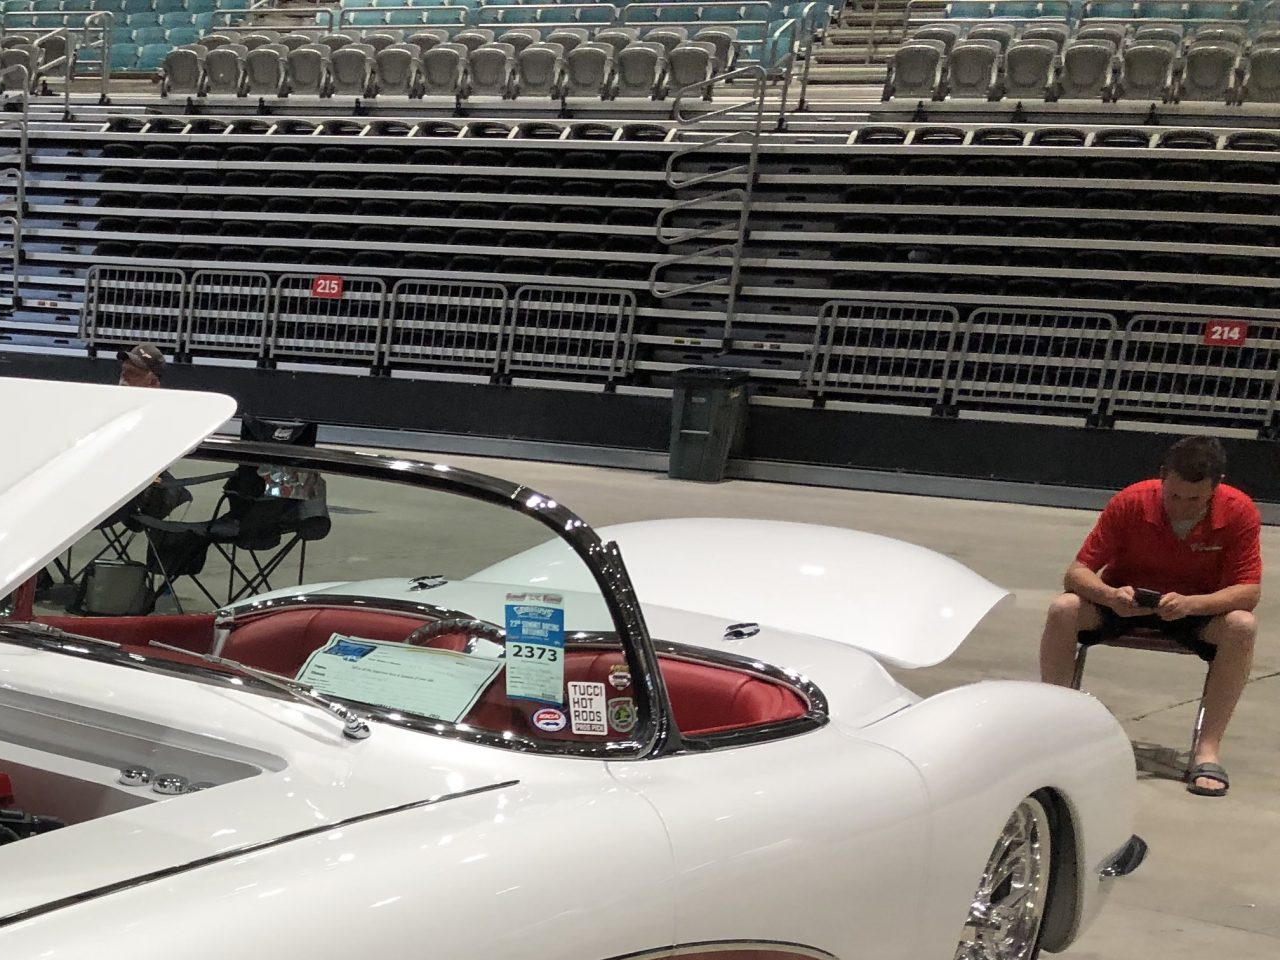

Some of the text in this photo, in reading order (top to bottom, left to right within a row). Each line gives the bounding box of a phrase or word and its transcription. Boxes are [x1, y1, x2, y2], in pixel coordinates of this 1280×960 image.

[317, 280, 338, 293] 215
[1211, 326, 1240, 340] 214
[512, 644, 558, 662] 2373
[571, 684, 603, 697] TUCCI
[573, 698, 594, 709] HOT
[573, 711, 602, 722] RODS
